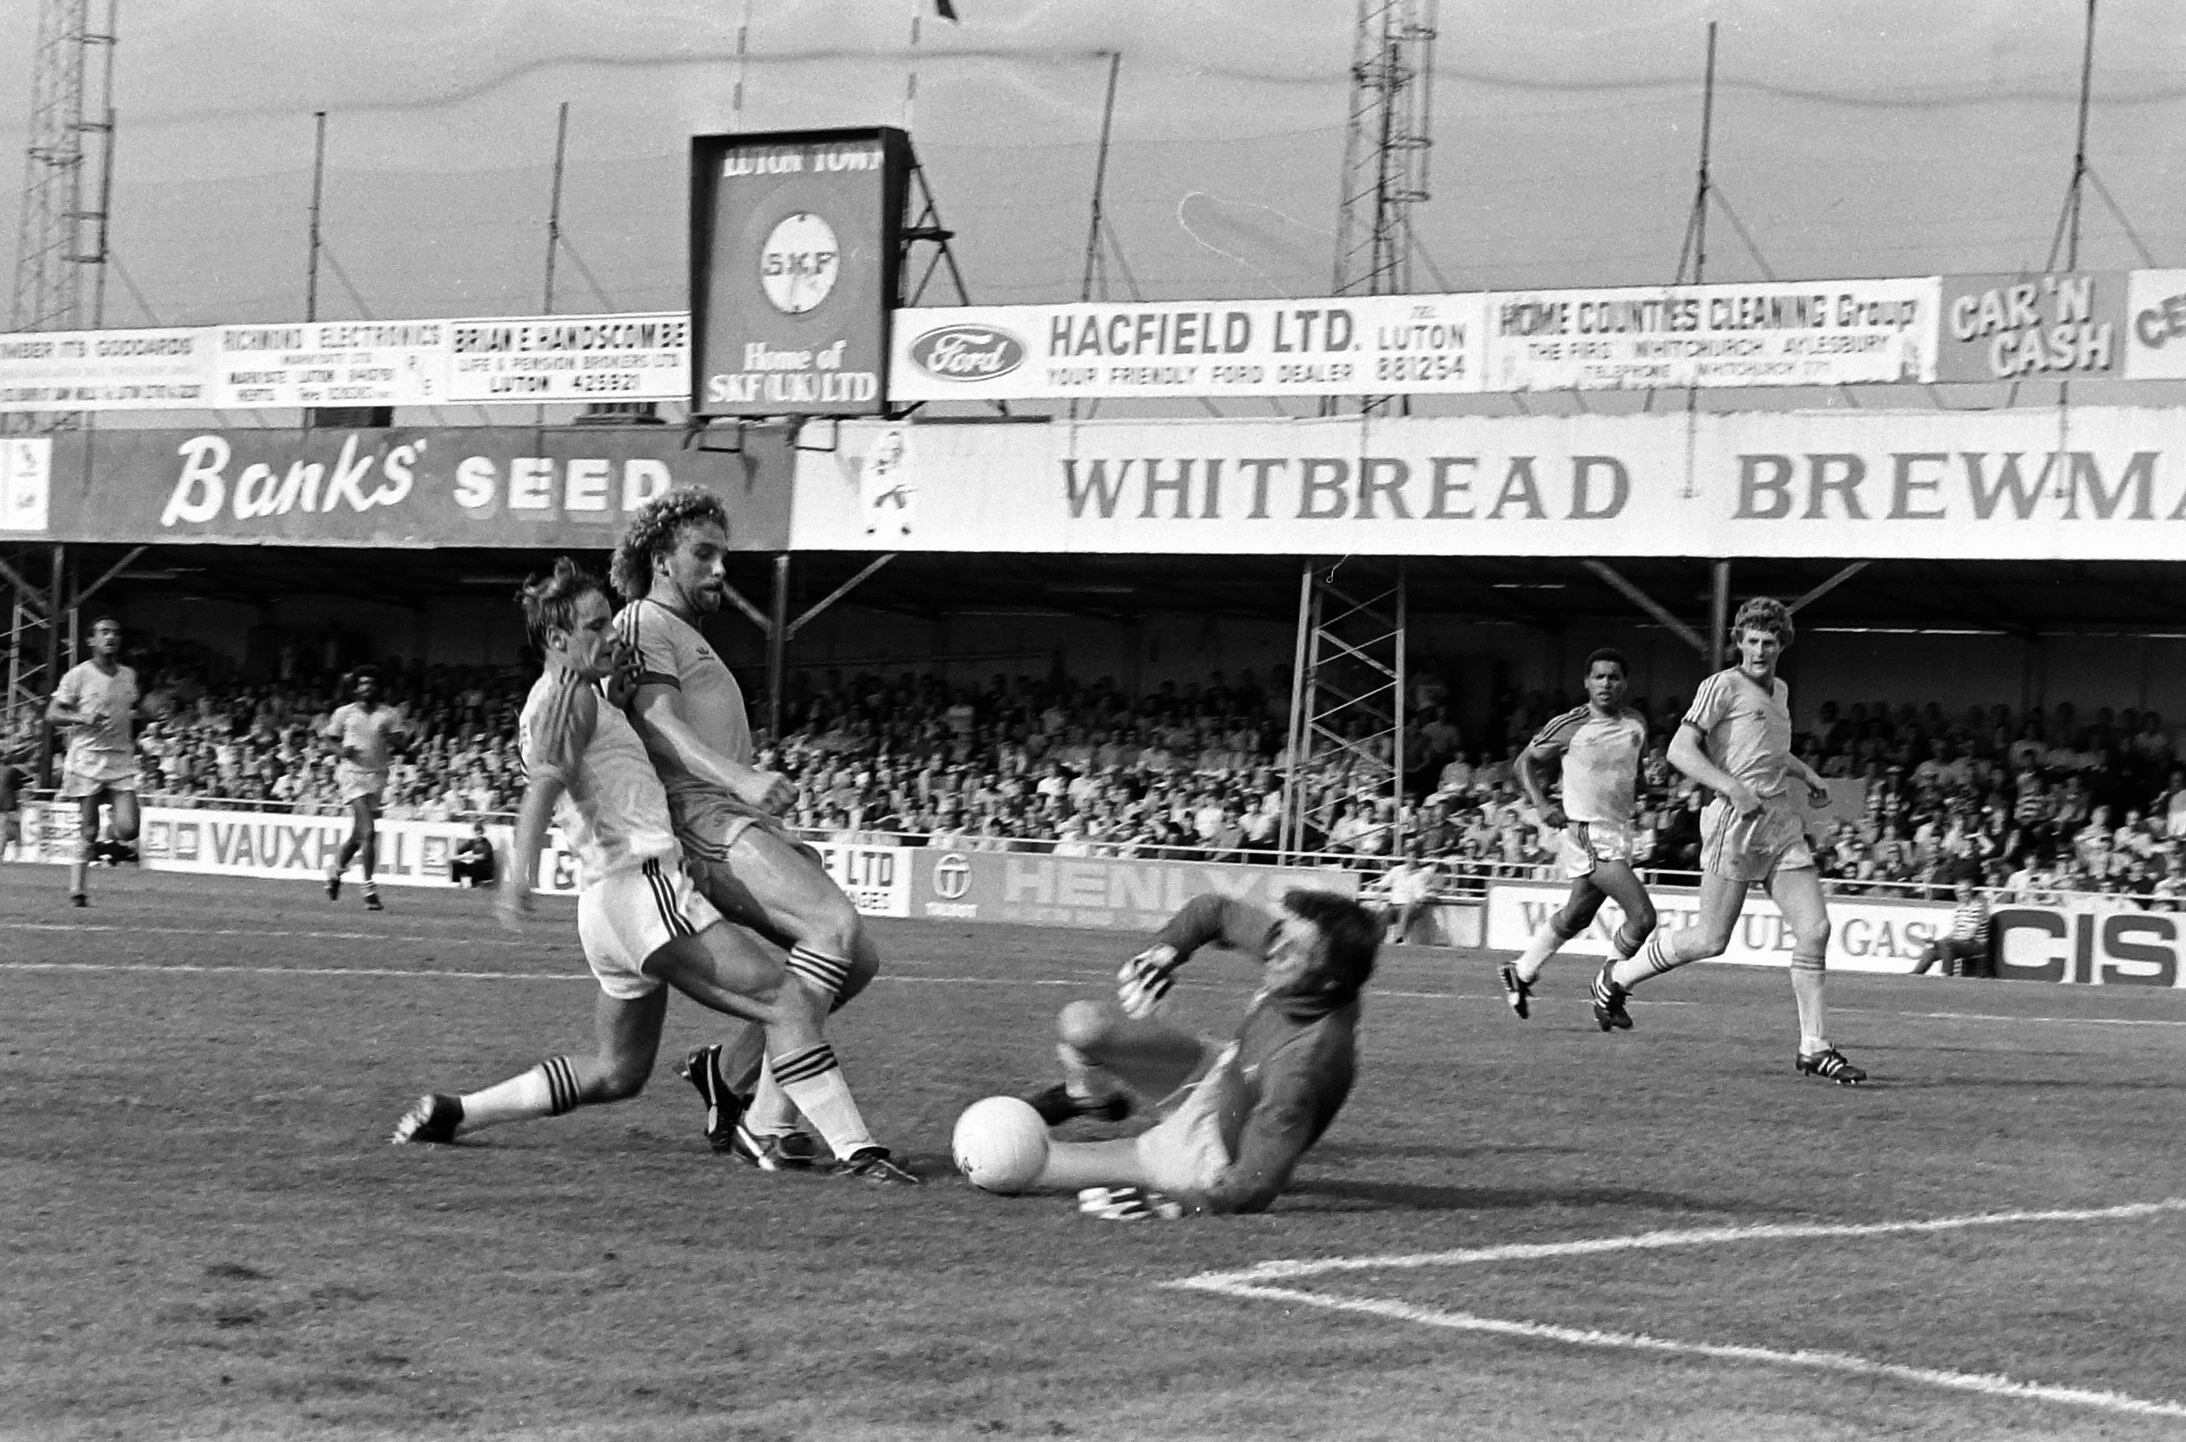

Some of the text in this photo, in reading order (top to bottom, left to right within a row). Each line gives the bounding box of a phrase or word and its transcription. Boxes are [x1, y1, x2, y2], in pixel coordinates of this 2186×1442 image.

[763, 250, 836, 277] SKF
[1499, 292, 1918, 335] HOME COUNTIES CLEANING Group
[1951, 283, 2041, 342] CAR
[319, 324, 439, 349] ELECTRONICS
[744, 339, 847, 371] Home of
[928, 333, 1008, 374] Ford
[1048, 311, 1252, 357] HACFIELD
[1377, 323, 1467, 351] LUTON
[1993, 322, 2113, 379] CASH
[707, 373, 764, 401] SKF
[823, 371, 878, 400] LTD
[1107, 364, 1199, 386] FRIENDLY
[1210, 363, 1264, 385] FORD
[1276, 362, 1352, 384] DEALER
[453, 455, 672, 512] SEED
[1060, 450, 2186, 521] WHITBREAD BREWM
[207, 821, 412, 876] VAUXHLL
[847, 849, 894, 887] LTD
[1988, 909, 2177, 988] CIS
